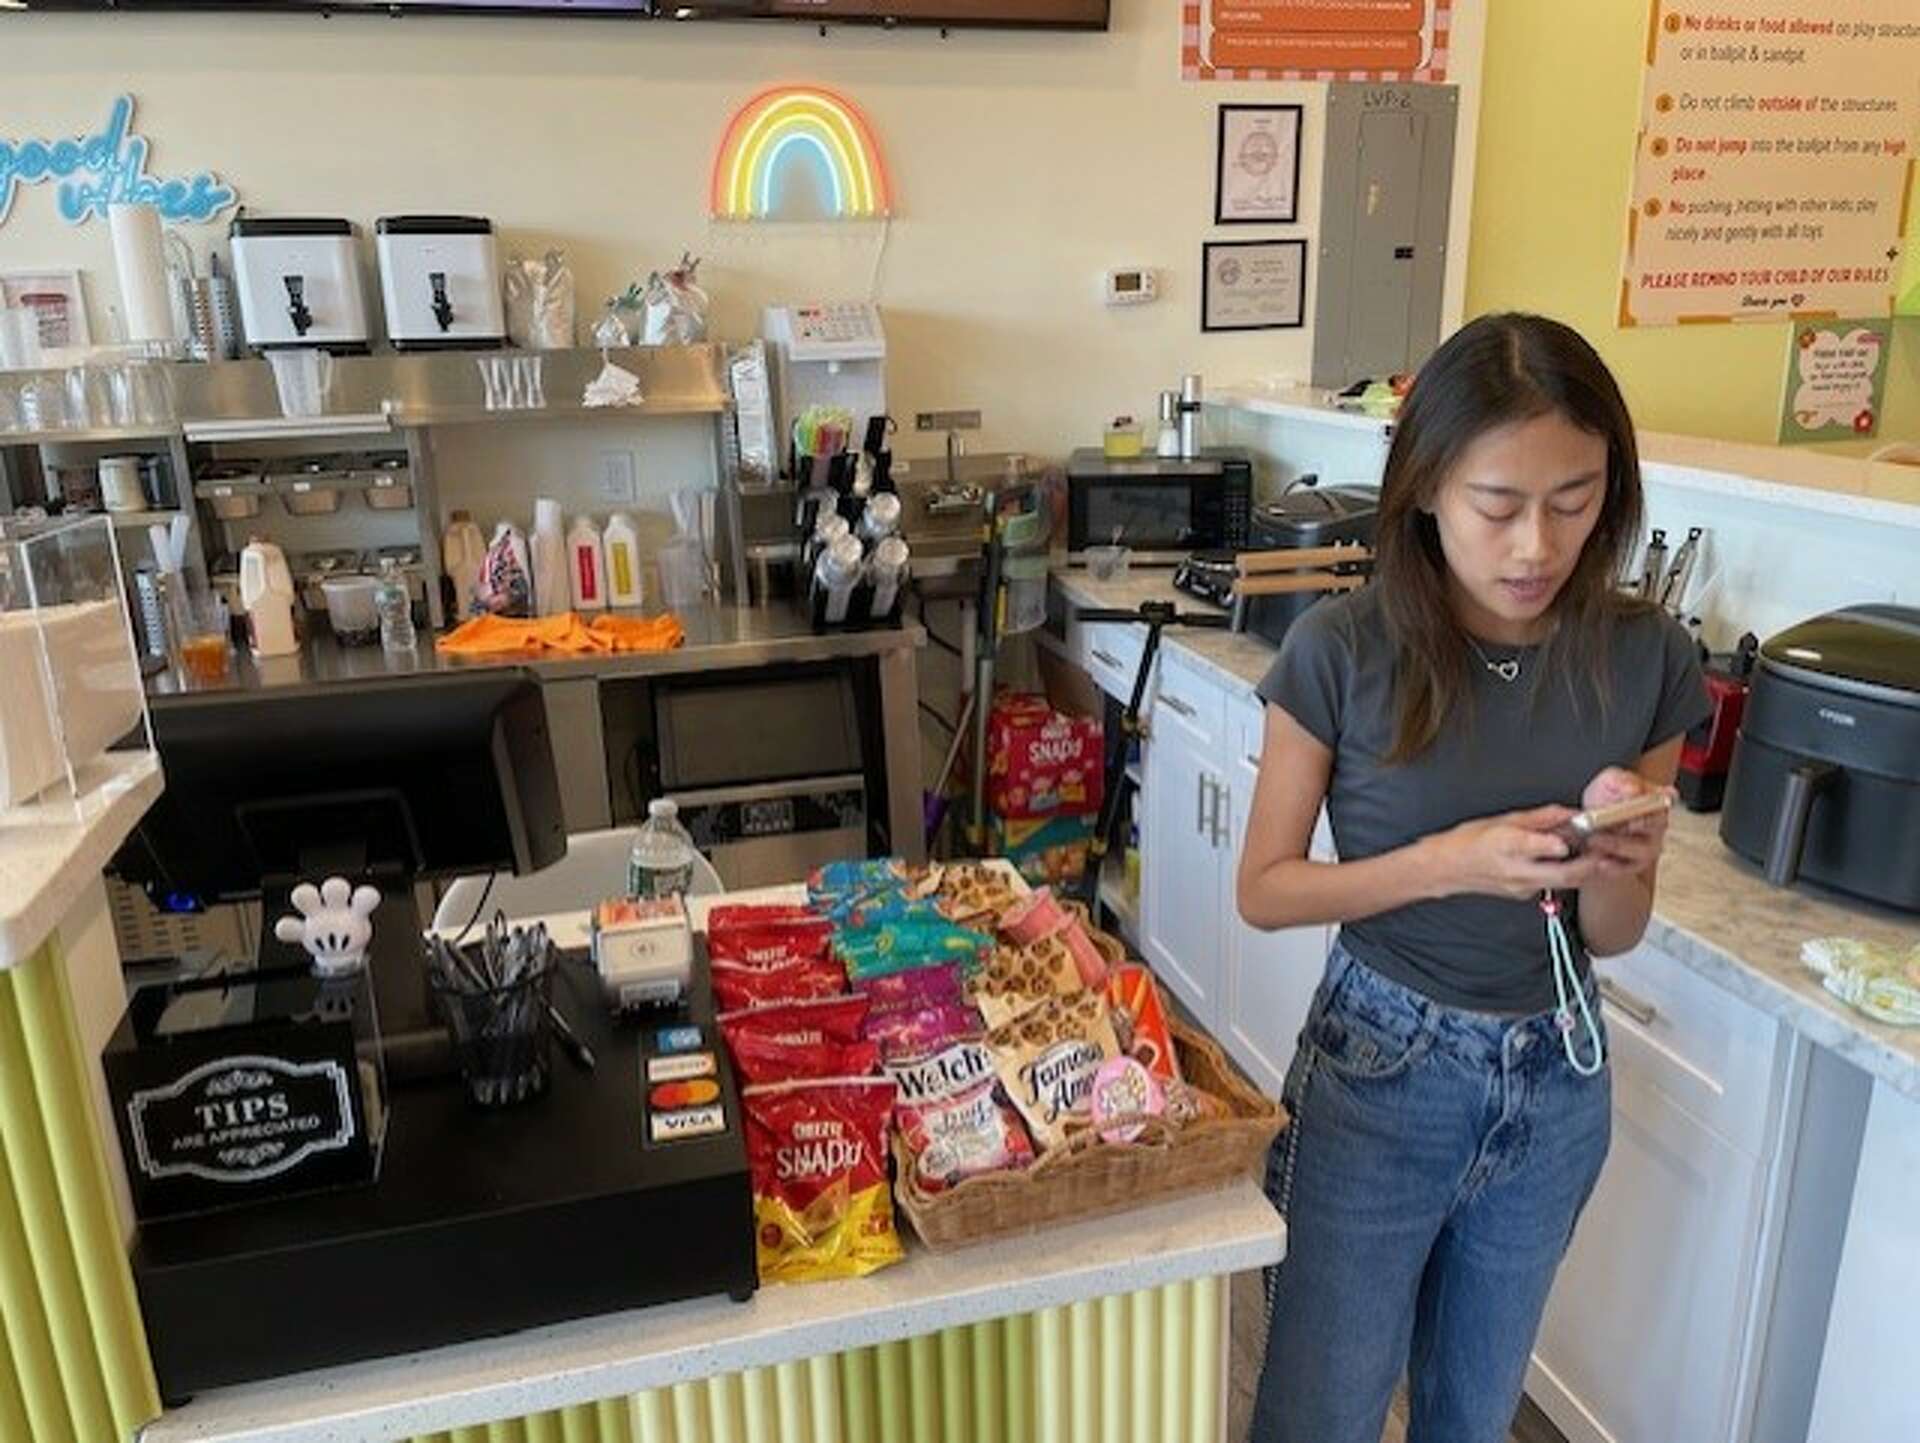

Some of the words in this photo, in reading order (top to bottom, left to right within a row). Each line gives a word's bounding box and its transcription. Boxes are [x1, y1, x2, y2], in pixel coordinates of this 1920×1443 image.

[1684, 16, 1701, 31] No
[1704, 15, 1741, 32] drinks
[1743, 20, 1756, 31] or
[1759, 17, 1785, 33] food
[1788, 19, 1834, 35] allowed
[1680, 48, 1693, 61] or
[1710, 46, 1747, 64] ballpit
[1749, 46, 1759, 62] &
[1680, 93, 1698, 111] Do
[1701, 96, 1720, 110] not
[1724, 95, 1755, 110] climb
[1758, 97, 1801, 112] outside
[1805, 96, 1820, 111] of
[1821, 97, 1838, 111] the
[1675, 137, 1693, 153] Do
[1695, 138, 1716, 153] not
[1716, 138, 1748, 157] jump
[1751, 139, 1773, 152] into
[1775, 138, 1794, 152] the
[1796, 138, 1830, 156] ballpit
[1833, 137, 1859, 152] from
[1862, 141, 1881, 156] any
[1669, 200, 1686, 214] No
[1775, 199, 1797, 212] with
[1800, 199, 1827, 212] other
[1665, 226, 1699, 242] nicely
[1701, 225, 1722, 240] and
[1725, 225, 1758, 243] gently
[1761, 223, 1783, 238] with
[1785, 222, 1798, 237] all
[1641, 272, 1689, 289] PLEASE
[1691, 270, 1737, 287] REMIND
[1738, 268, 1771, 286] YOUR
[1775, 268, 1810, 285] CHILD
[1811, 268, 1825, 283] OF
[1827, 267, 1851, 283] OUR
[1853, 266, 1890, 283] RULES
[194, 1093, 289, 1129] TIPS
[665, 1115, 713, 1128] VISA
[172, 1135, 203, 1150] ARE
[209, 1114, 320, 1145] APPRECIATED
